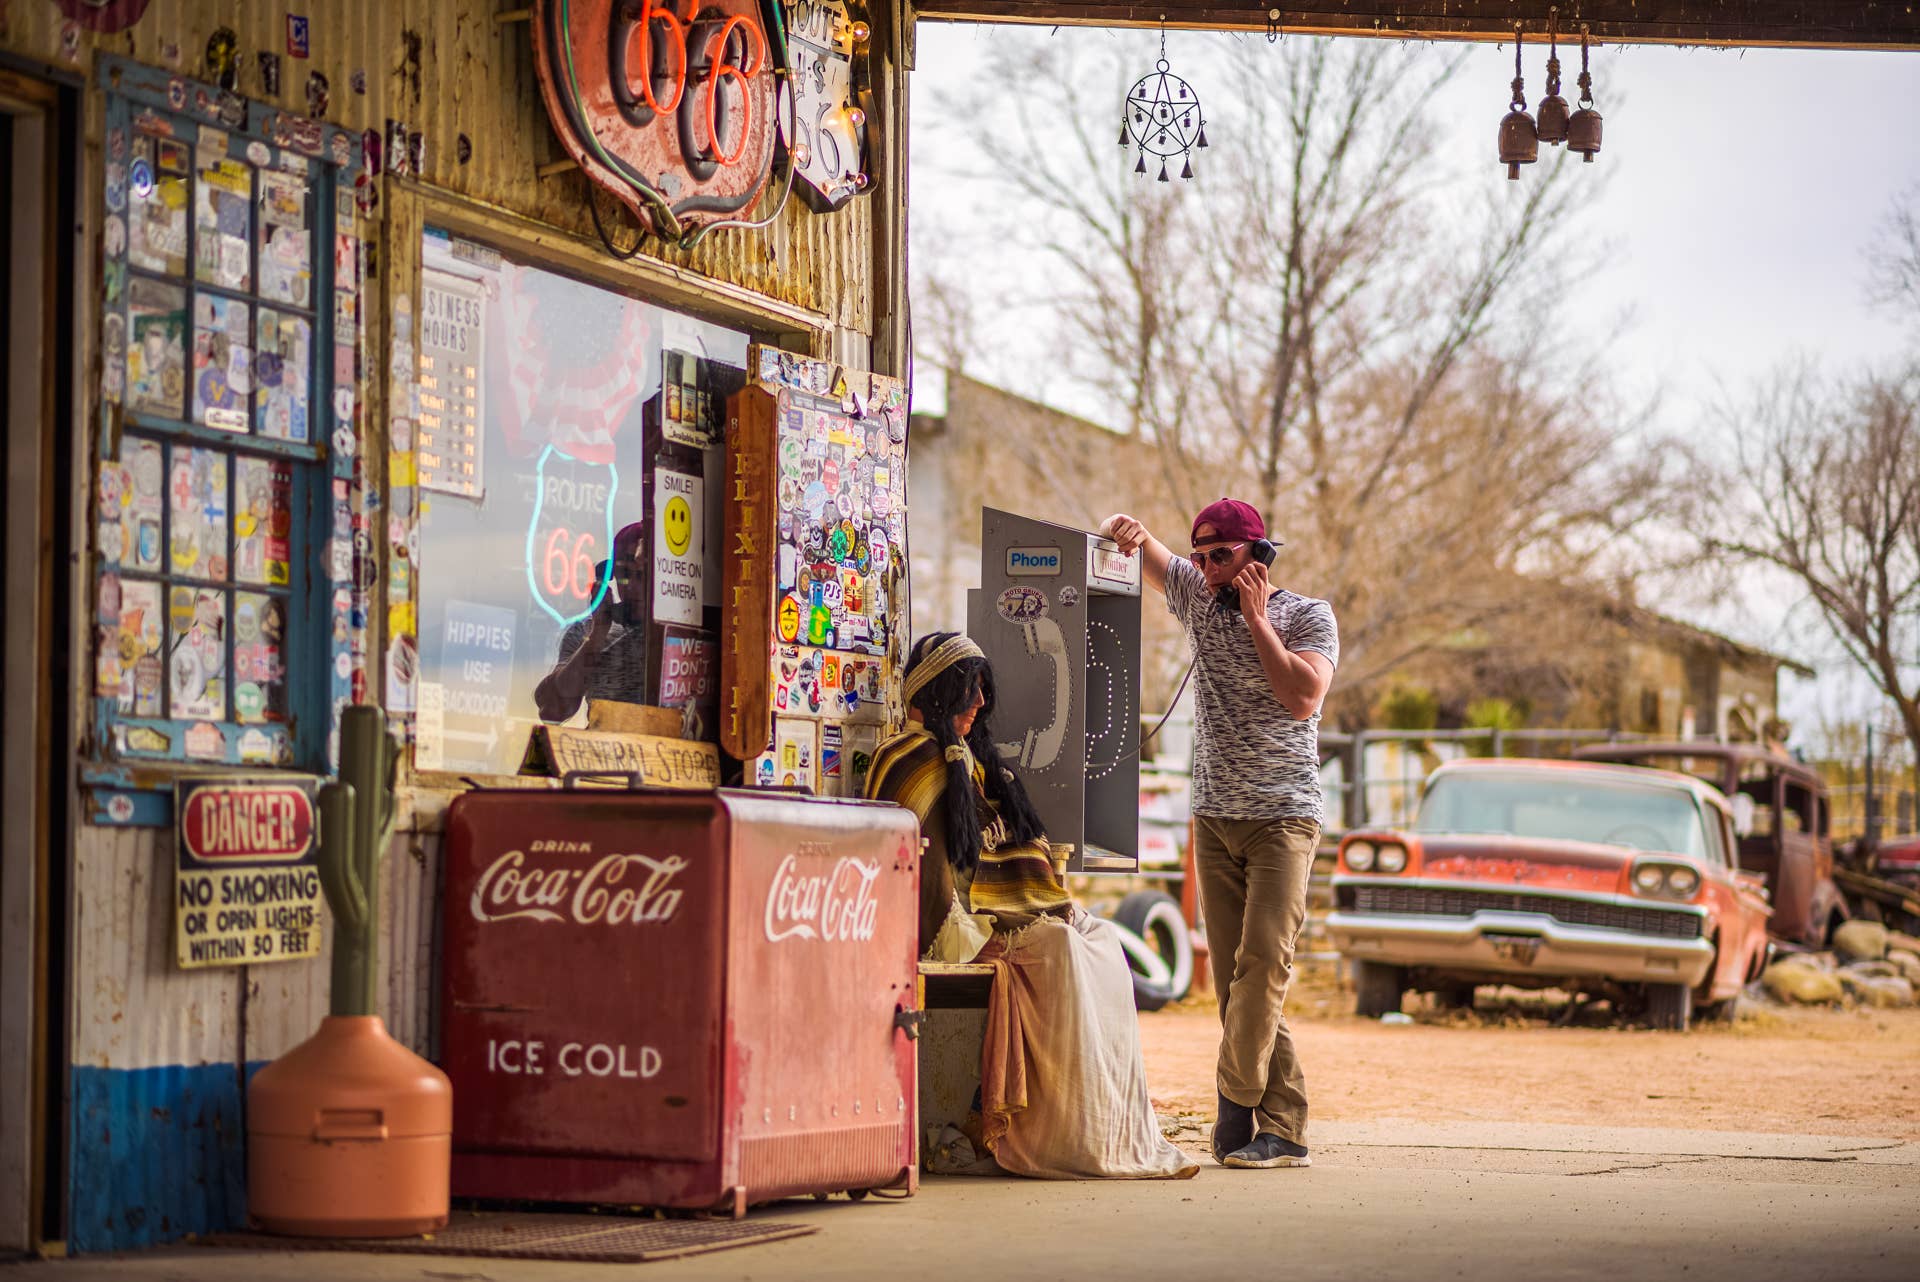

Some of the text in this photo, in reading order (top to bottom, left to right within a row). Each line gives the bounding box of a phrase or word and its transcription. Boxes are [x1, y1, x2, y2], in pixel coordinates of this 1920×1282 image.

[423, 319, 467, 353] HOURS
[544, 475, 607, 514] ROUTE
[664, 475, 694, 495] SMILE!
[543, 527, 596, 601] 66
[656, 558, 702, 579] YOU'RE ON
[1011, 552, 1058, 568] Phone
[660, 580, 697, 600] CAMERA
[1004, 588, 1022, 598] MOTO
[447, 620, 512, 652] HIPPIES
[679, 637, 703, 657] WE
[463, 658, 493, 683] USE
[669, 659, 710, 677] DON'T
[442, 688, 508, 718] BACKDOOR
[559, 732, 717, 784] GENERAL STORE
[200, 793, 297, 854] DANGER
[530, 839, 592, 853] DRINK
[180, 871, 319, 908] NO SMOKING
[470, 850, 691, 926] Coca-Cola
[764, 853, 882, 943] Coca-Cola
[185, 906, 315, 935] OR OPEN LIGHTS
[190, 931, 311, 962] WITHIN 50 FEET
[488, 1039, 663, 1079] ICE COLD
